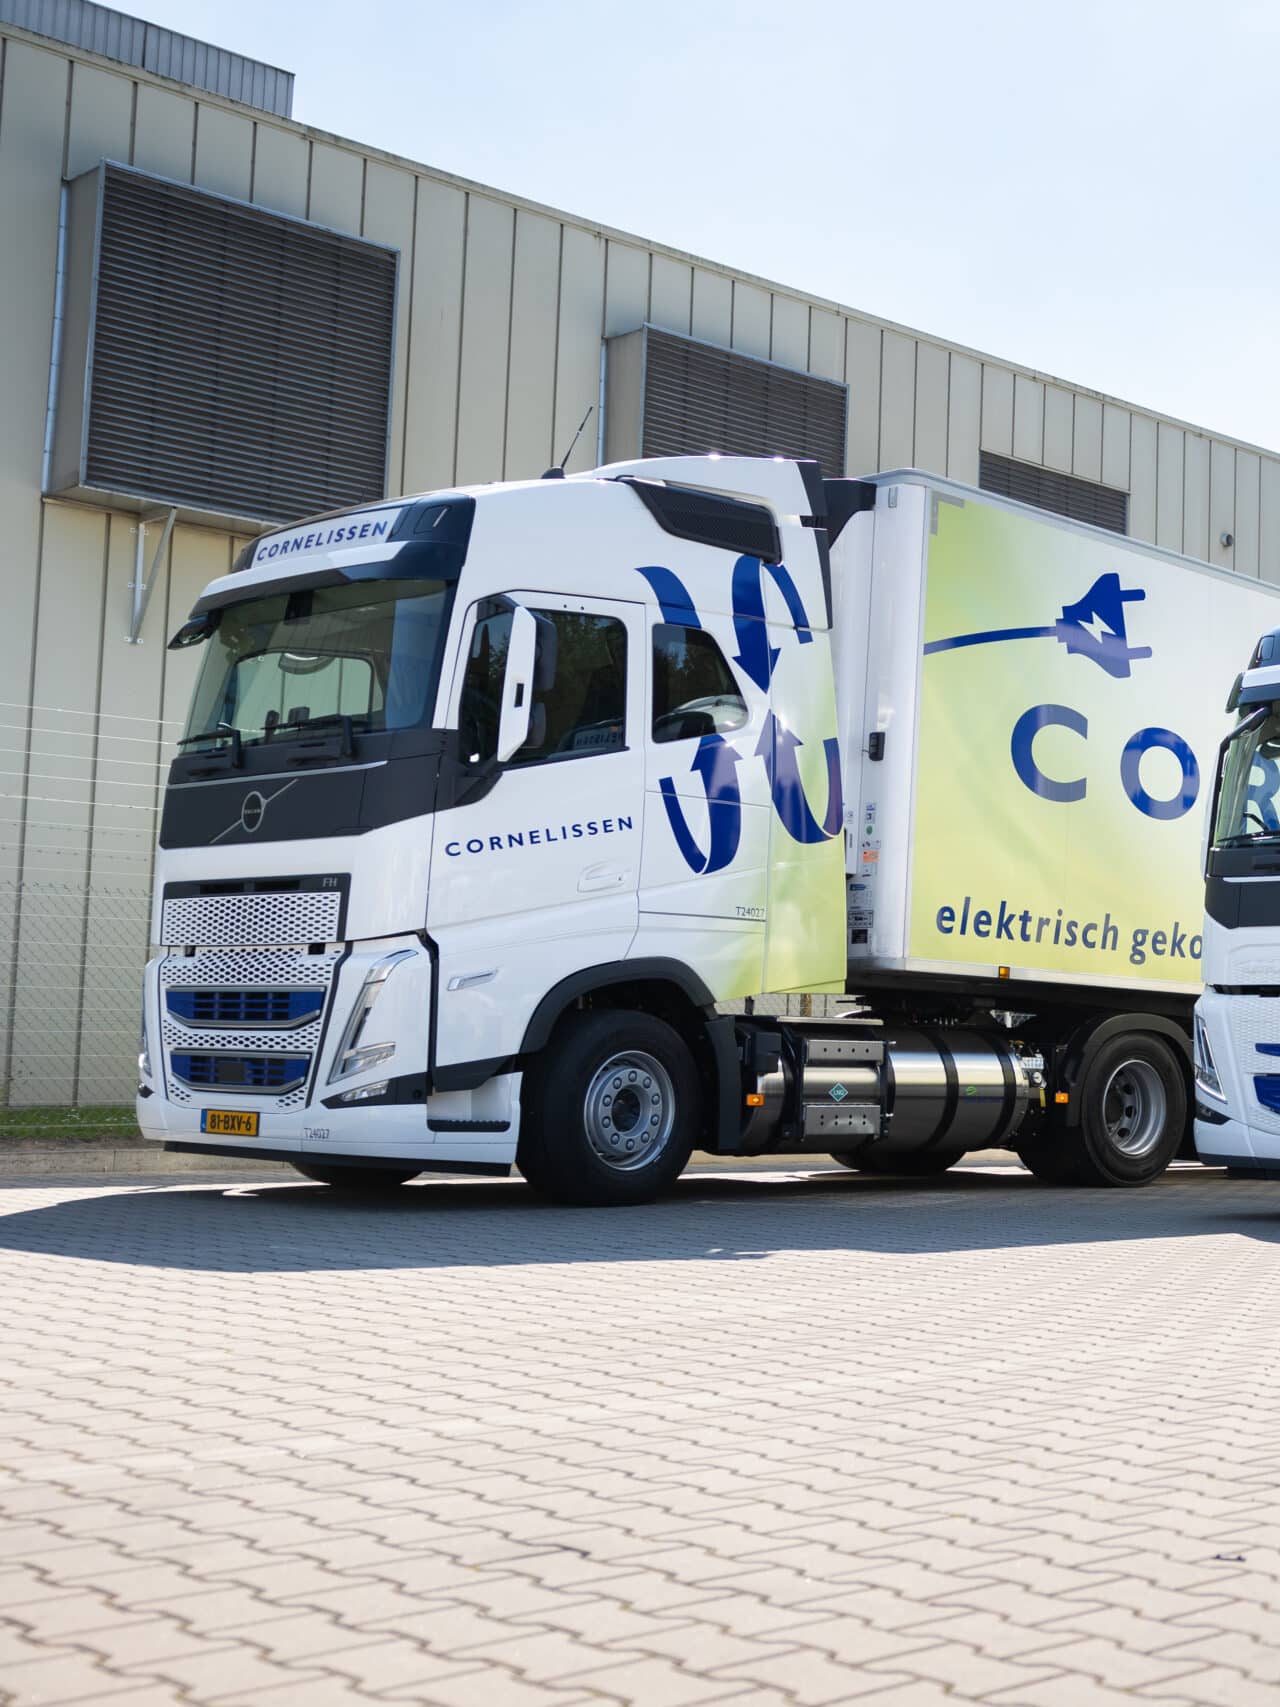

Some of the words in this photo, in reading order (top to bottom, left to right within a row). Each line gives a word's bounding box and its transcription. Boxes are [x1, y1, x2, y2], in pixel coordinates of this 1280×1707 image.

[257, 520, 388, 561] CORNELISSEN
[445, 816, 633, 856] CORNELISSEN
[322, 877, 338, 887] FH
[936, 896, 1119, 951] elektrisch
[210, 1114, 252, 1131] 81-BXV-6
